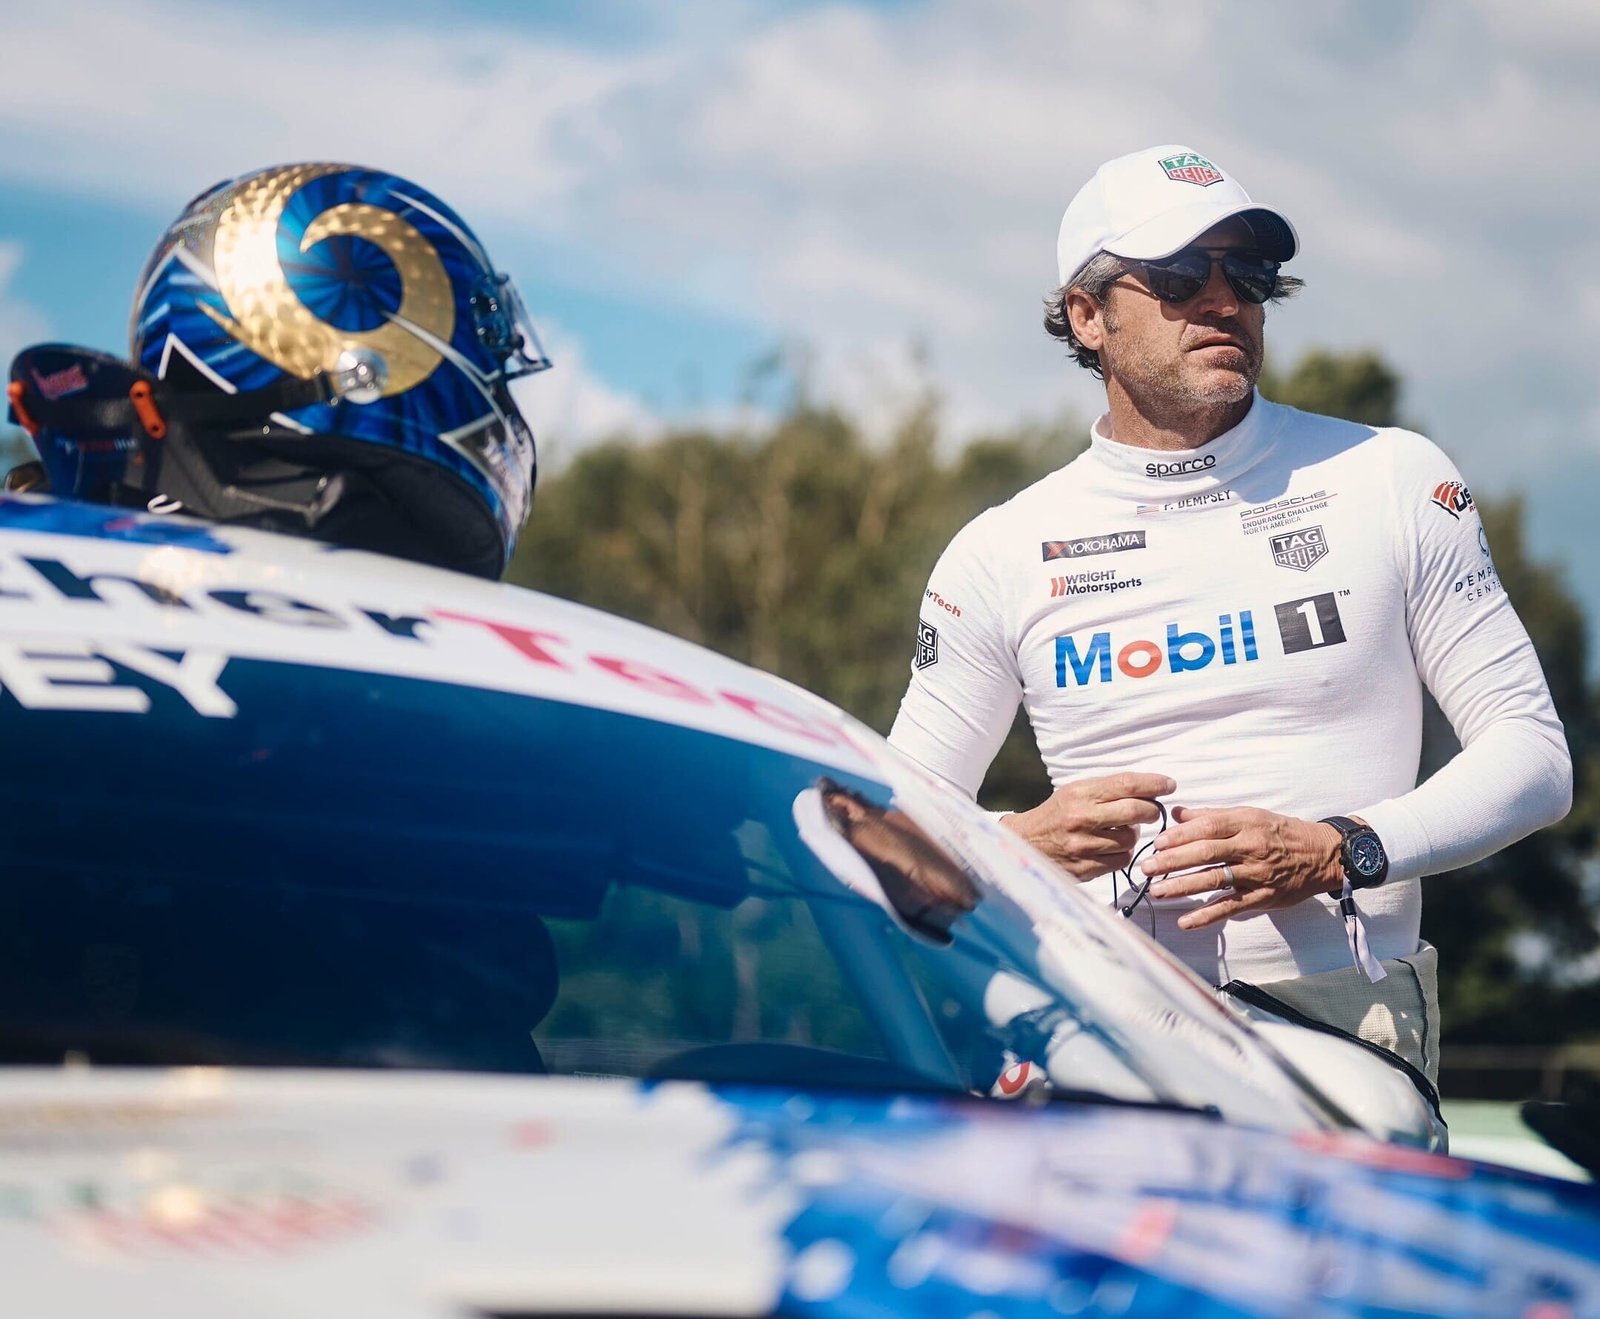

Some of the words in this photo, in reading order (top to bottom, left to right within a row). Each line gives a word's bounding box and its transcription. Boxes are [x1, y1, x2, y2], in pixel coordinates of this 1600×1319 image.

[1165, 155, 1215, 168] TAG
[1171, 167, 1220, 183] HEUER
[1145, 454, 1216, 478] sparco
[1177, 489, 1231, 509] DEMPSEY
[1240, 489, 1327, 518] PORSCHE
[1242, 512, 1286, 530] ENDURANCE
[1287, 501, 1329, 518] CHALLENGE
[1243, 524, 1269, 536] NORTH
[1270, 515, 1302, 531] AMERICA
[1068, 533, 1140, 555] YOKOHAMA
[1274, 530, 1320, 551] TAG
[1278, 543, 1325, 568] HEUER
[1065, 577, 1143, 596] Motorsports
[1055, 609, 1260, 689] Mobil
[1295, 599, 1326, 646] 1
[0, 640, 239, 719] EY
